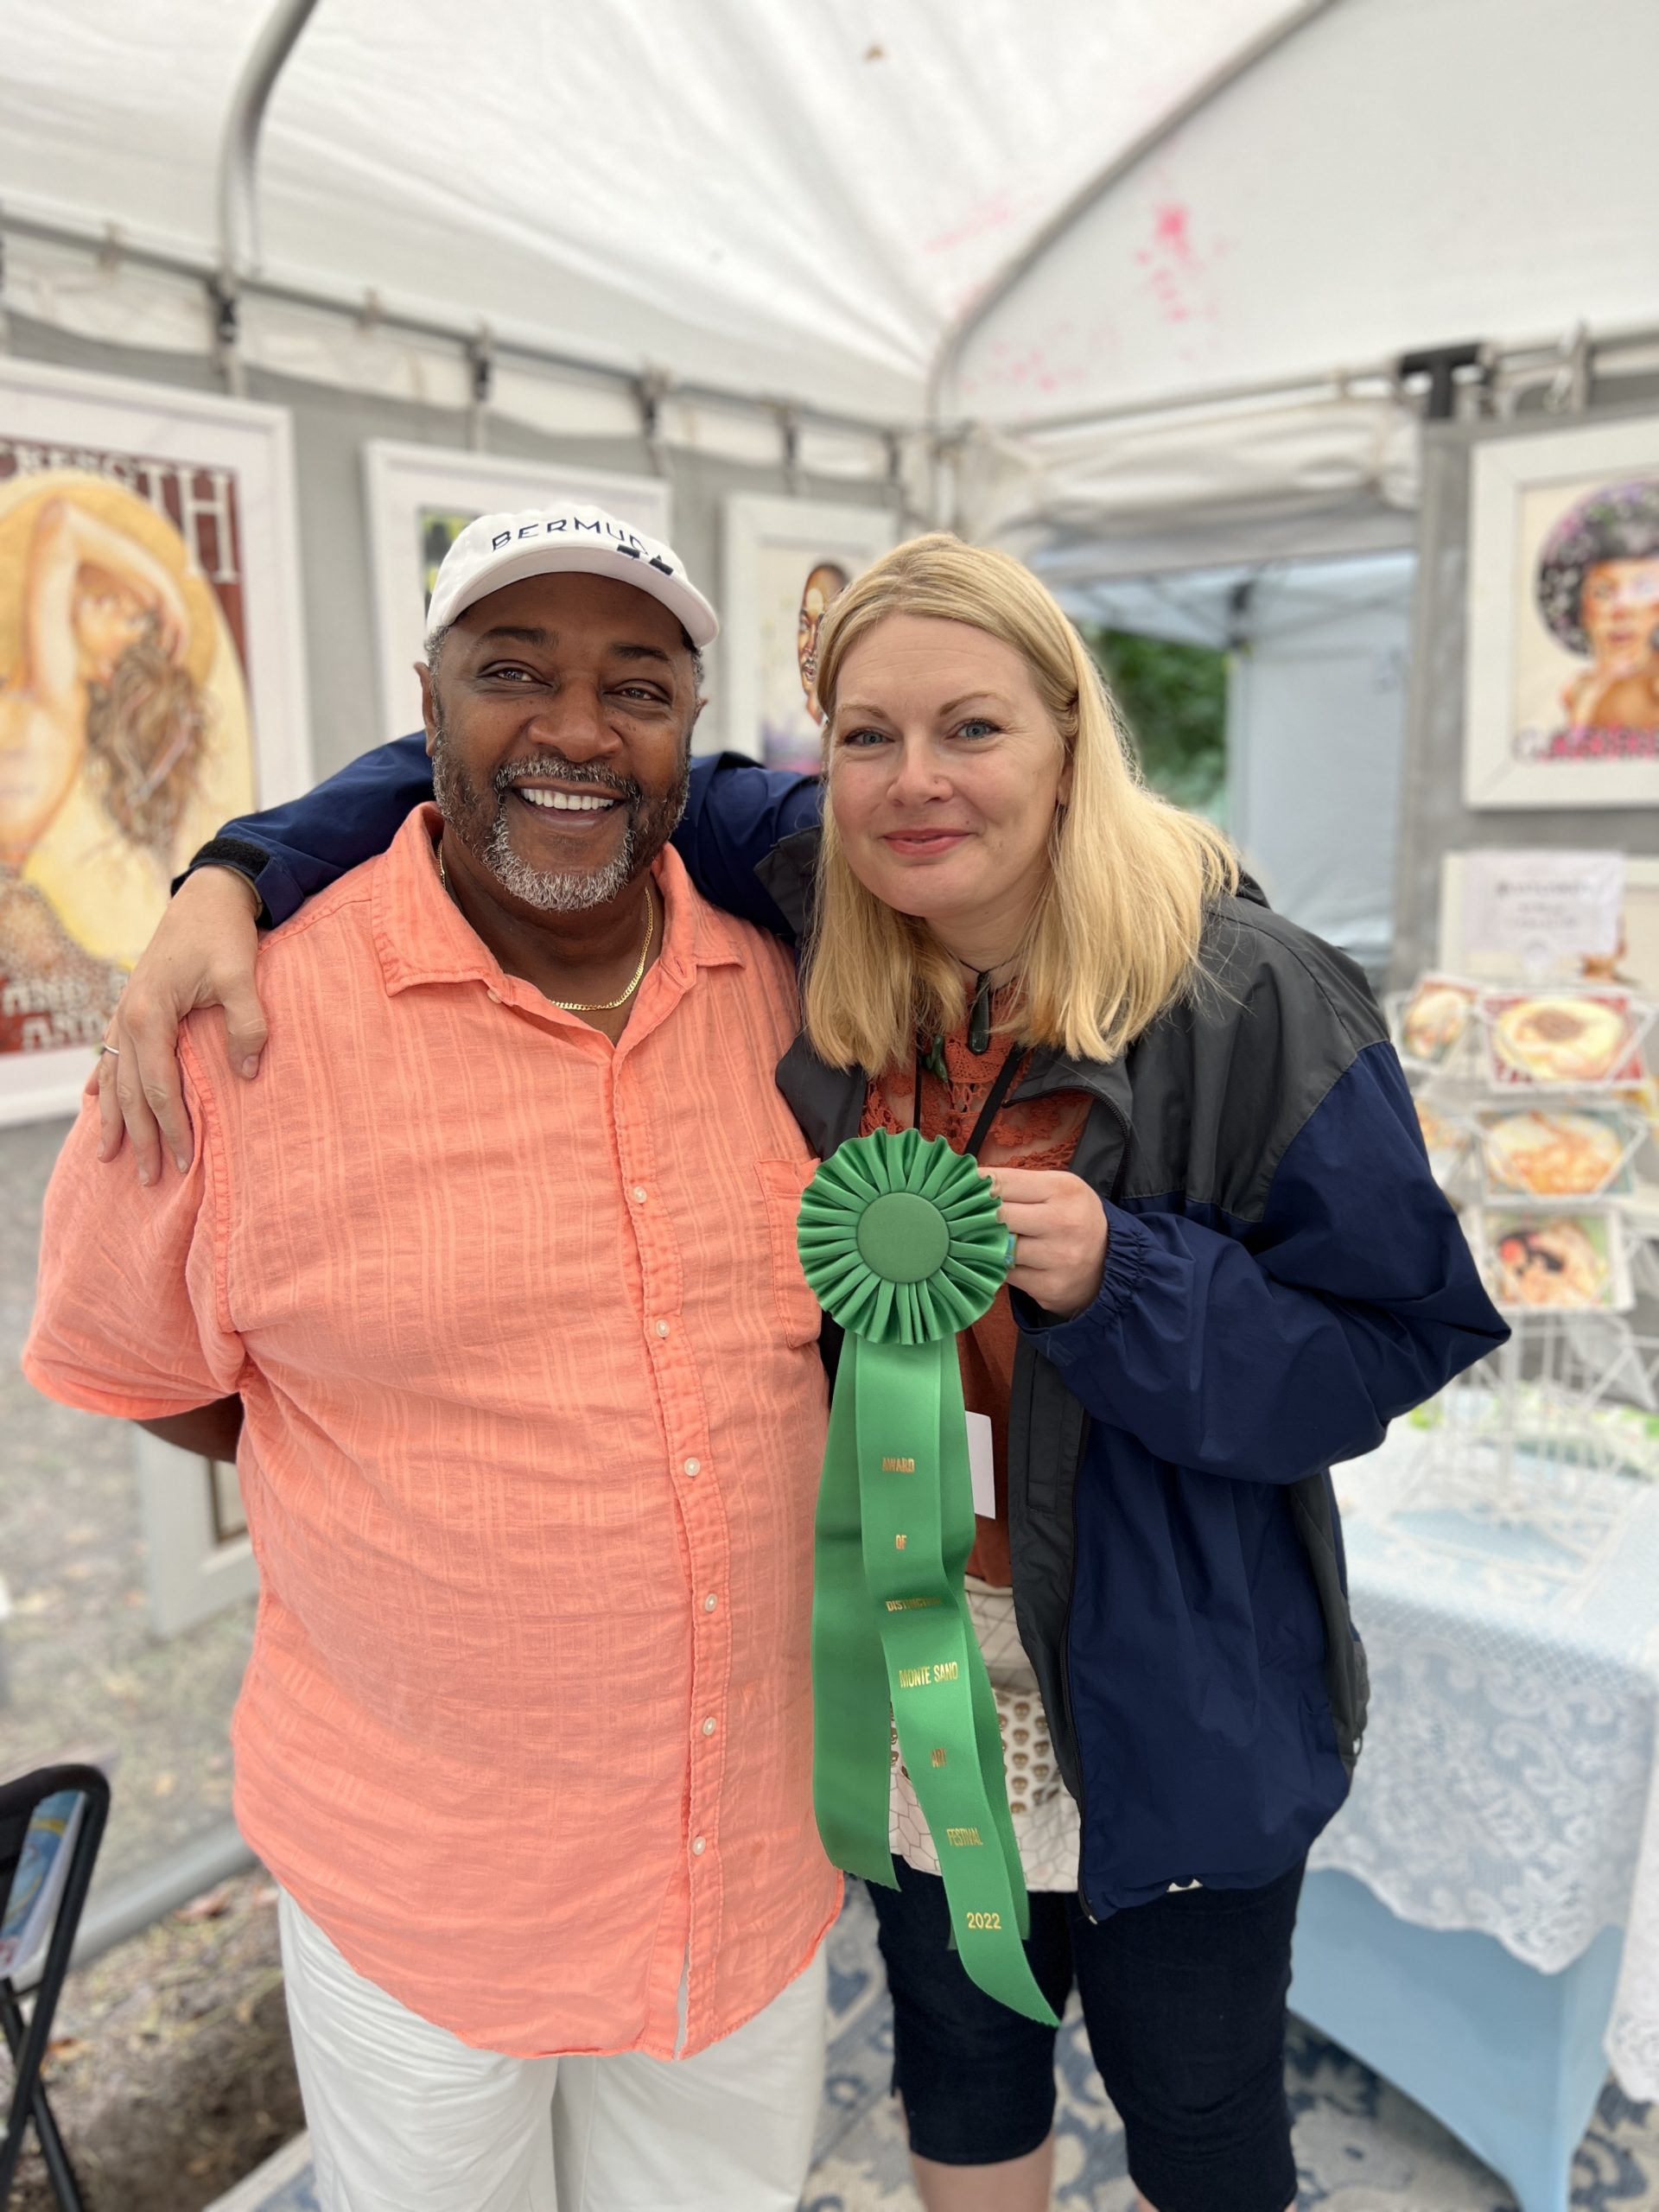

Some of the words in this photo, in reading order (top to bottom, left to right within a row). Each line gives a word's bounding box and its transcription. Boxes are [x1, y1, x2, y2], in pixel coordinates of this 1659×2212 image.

[492, 517, 664, 563] BERMUD
[881, 1458, 915, 1473] AWARD
[895, 1535, 907, 1549] OF
[899, 1666, 931, 1688] MONTE
[934, 1662, 958, 1682] SANO
[931, 1748, 947, 1768] ART
[946, 1827, 983, 1846] FESTIVAL
[966, 1912, 1001, 1929] 2022
